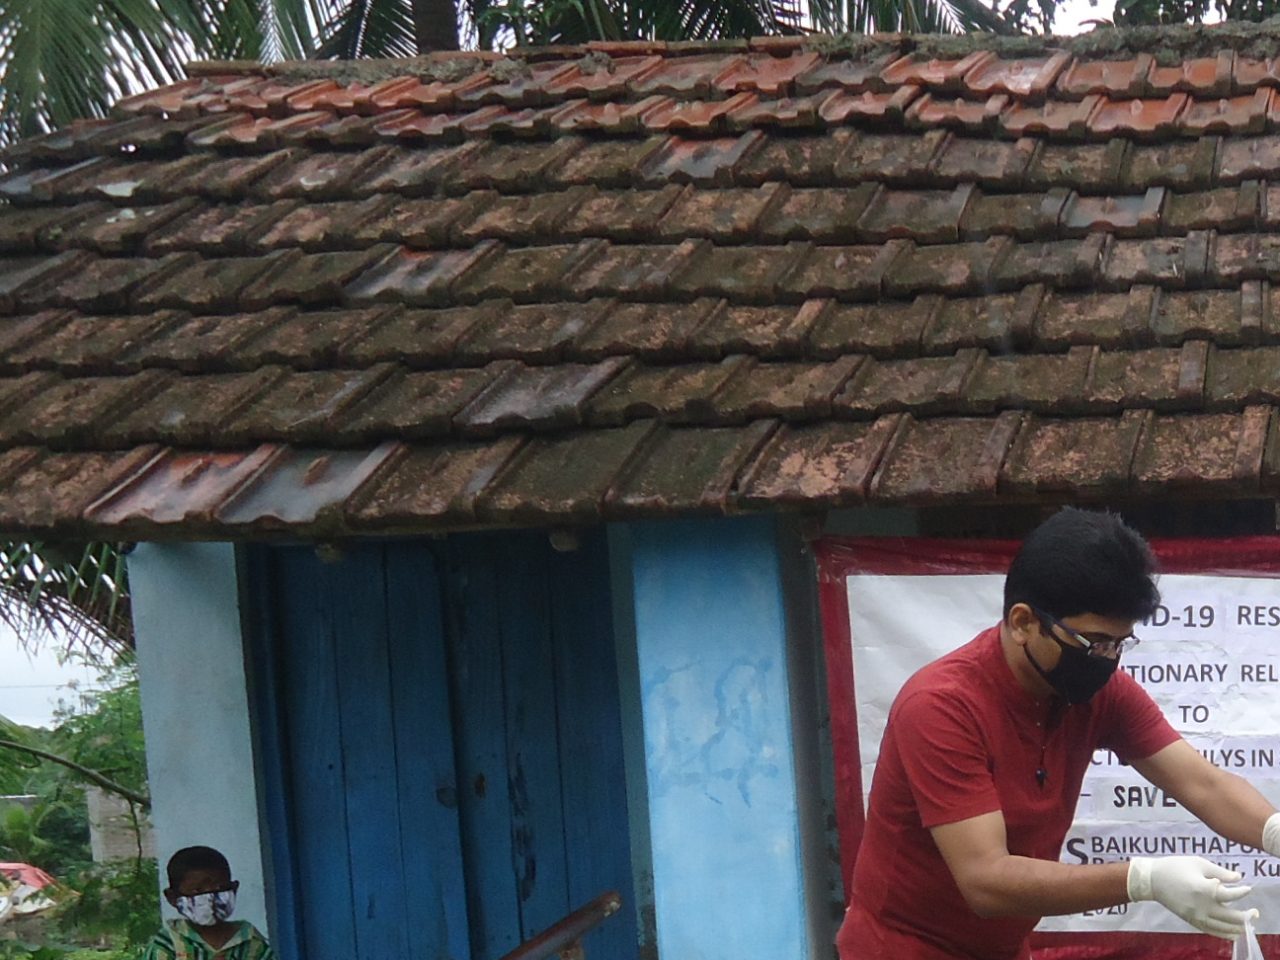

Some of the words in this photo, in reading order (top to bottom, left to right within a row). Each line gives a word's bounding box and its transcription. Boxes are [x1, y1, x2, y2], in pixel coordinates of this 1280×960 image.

[1143, 604, 1215, 629] D-19
[1121, 664, 1229, 684] TIONARY
[1179, 705, 1210, 723] TO
[1251, 749, 1274, 767] IN
